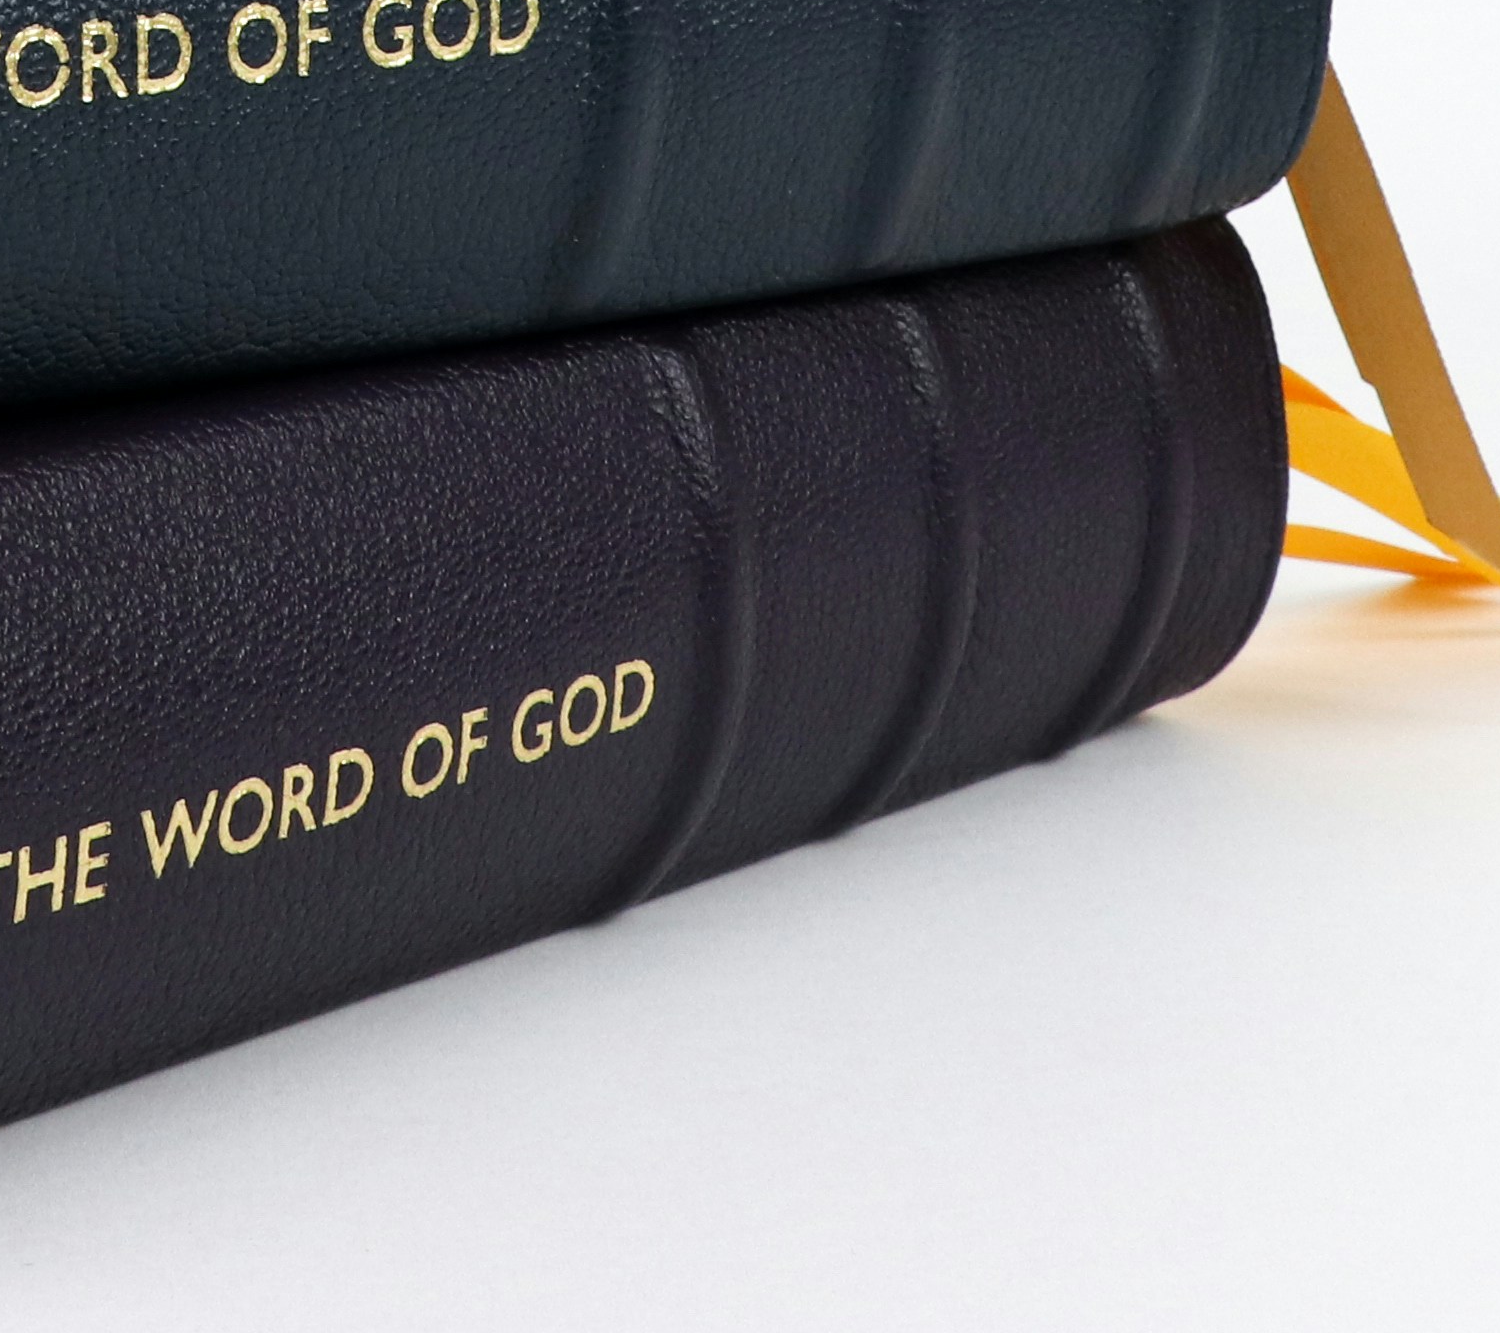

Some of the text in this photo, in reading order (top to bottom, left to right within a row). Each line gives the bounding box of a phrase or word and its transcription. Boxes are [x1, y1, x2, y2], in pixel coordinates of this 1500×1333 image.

[140, 746, 376, 880] WORD
[400, 705, 490, 800] OF
[511, 657, 656, 765] GOD
